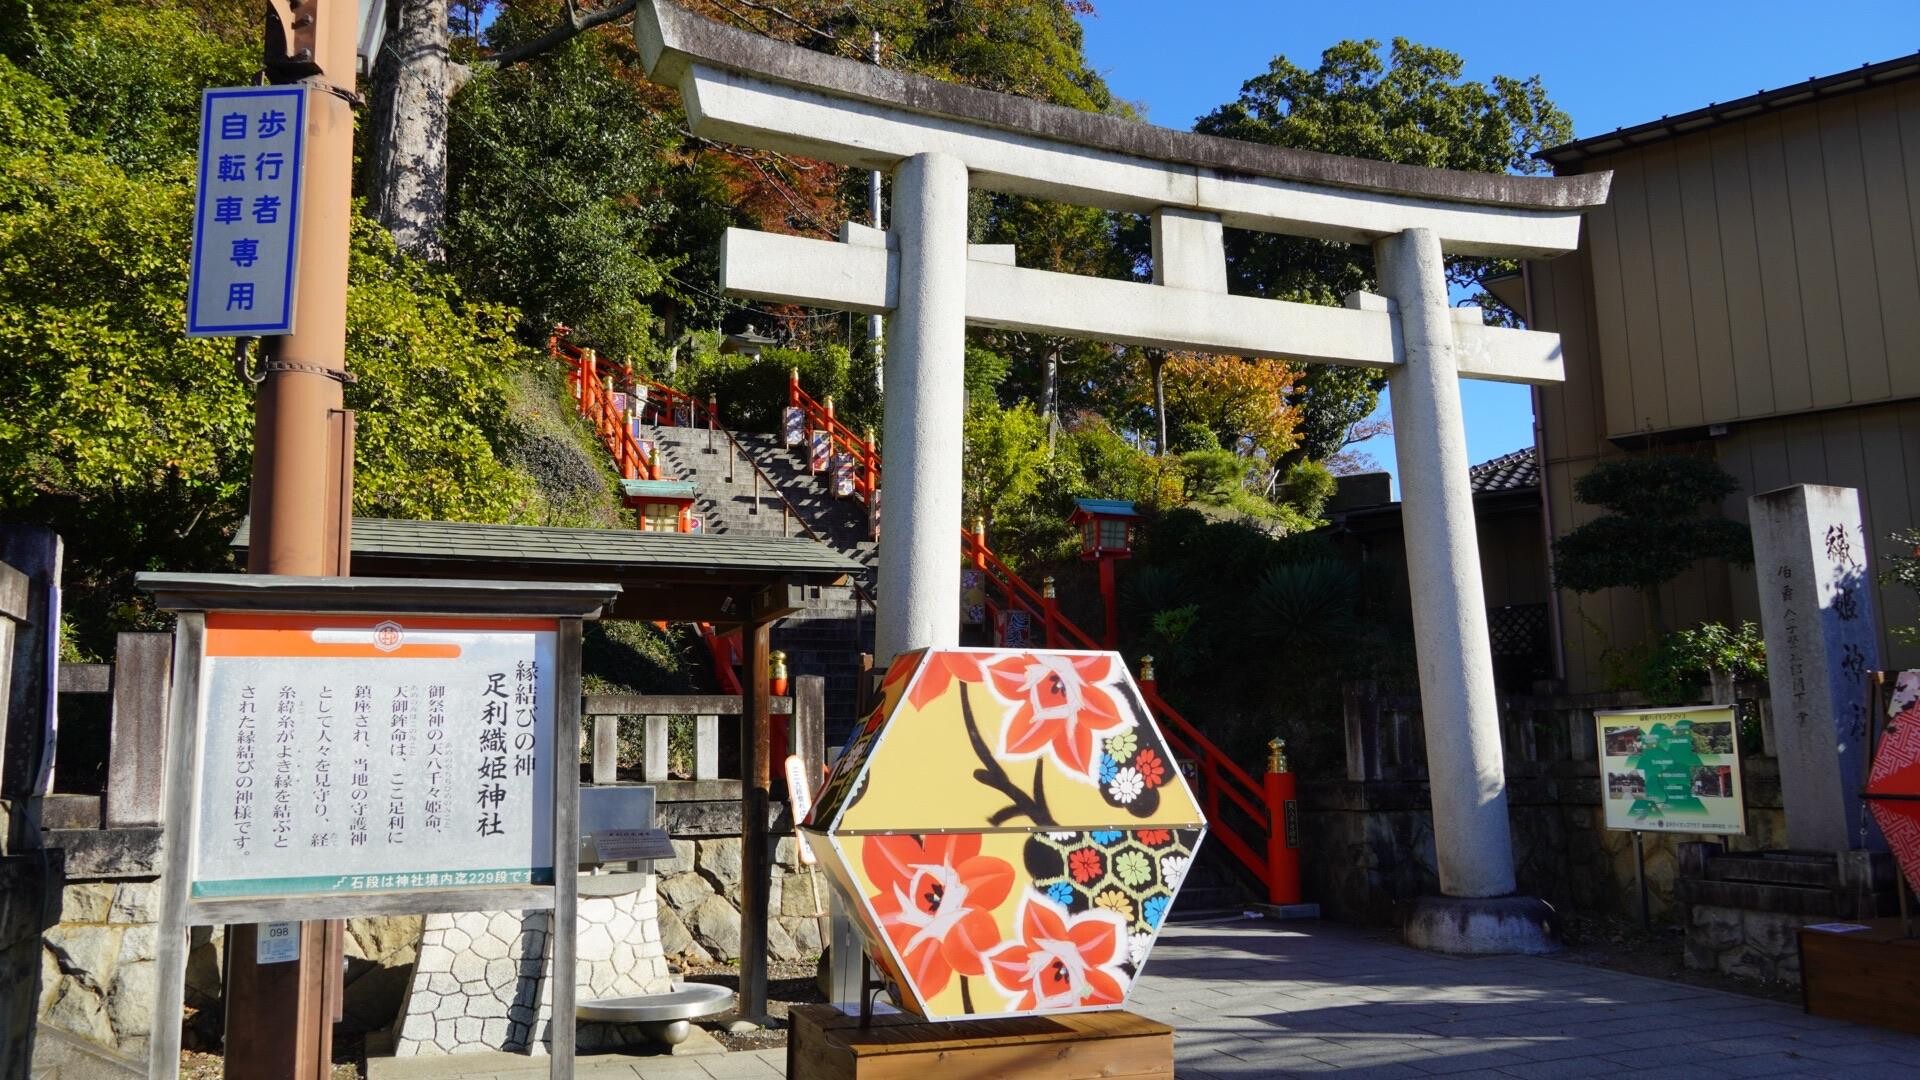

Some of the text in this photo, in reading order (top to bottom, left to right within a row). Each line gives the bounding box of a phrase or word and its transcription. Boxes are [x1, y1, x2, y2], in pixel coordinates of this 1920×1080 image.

[214, 111, 248, 225] 自転車
[252, 109, 287, 224] 歩行者
[226, 238, 260, 311] 専用
[233, 685, 257, 856] された縁結びの神様です。
[272, 685, 297, 848] 糸緯糸がよき縁を結ぶと
[311, 685, 334, 847] として人々を見守り、経
[350, 685, 372, 846] 鎮座され、当地の守護神
[424, 685, 446, 833] 御祭神の天八千々姫命、
[476, 672, 510, 838] 足利織姫神社
[514, 660, 538, 777] 縁結びの神
[269, 927, 289, 938] 098
[351, 871, 535, 889] 石段は神社境内迄229段です
